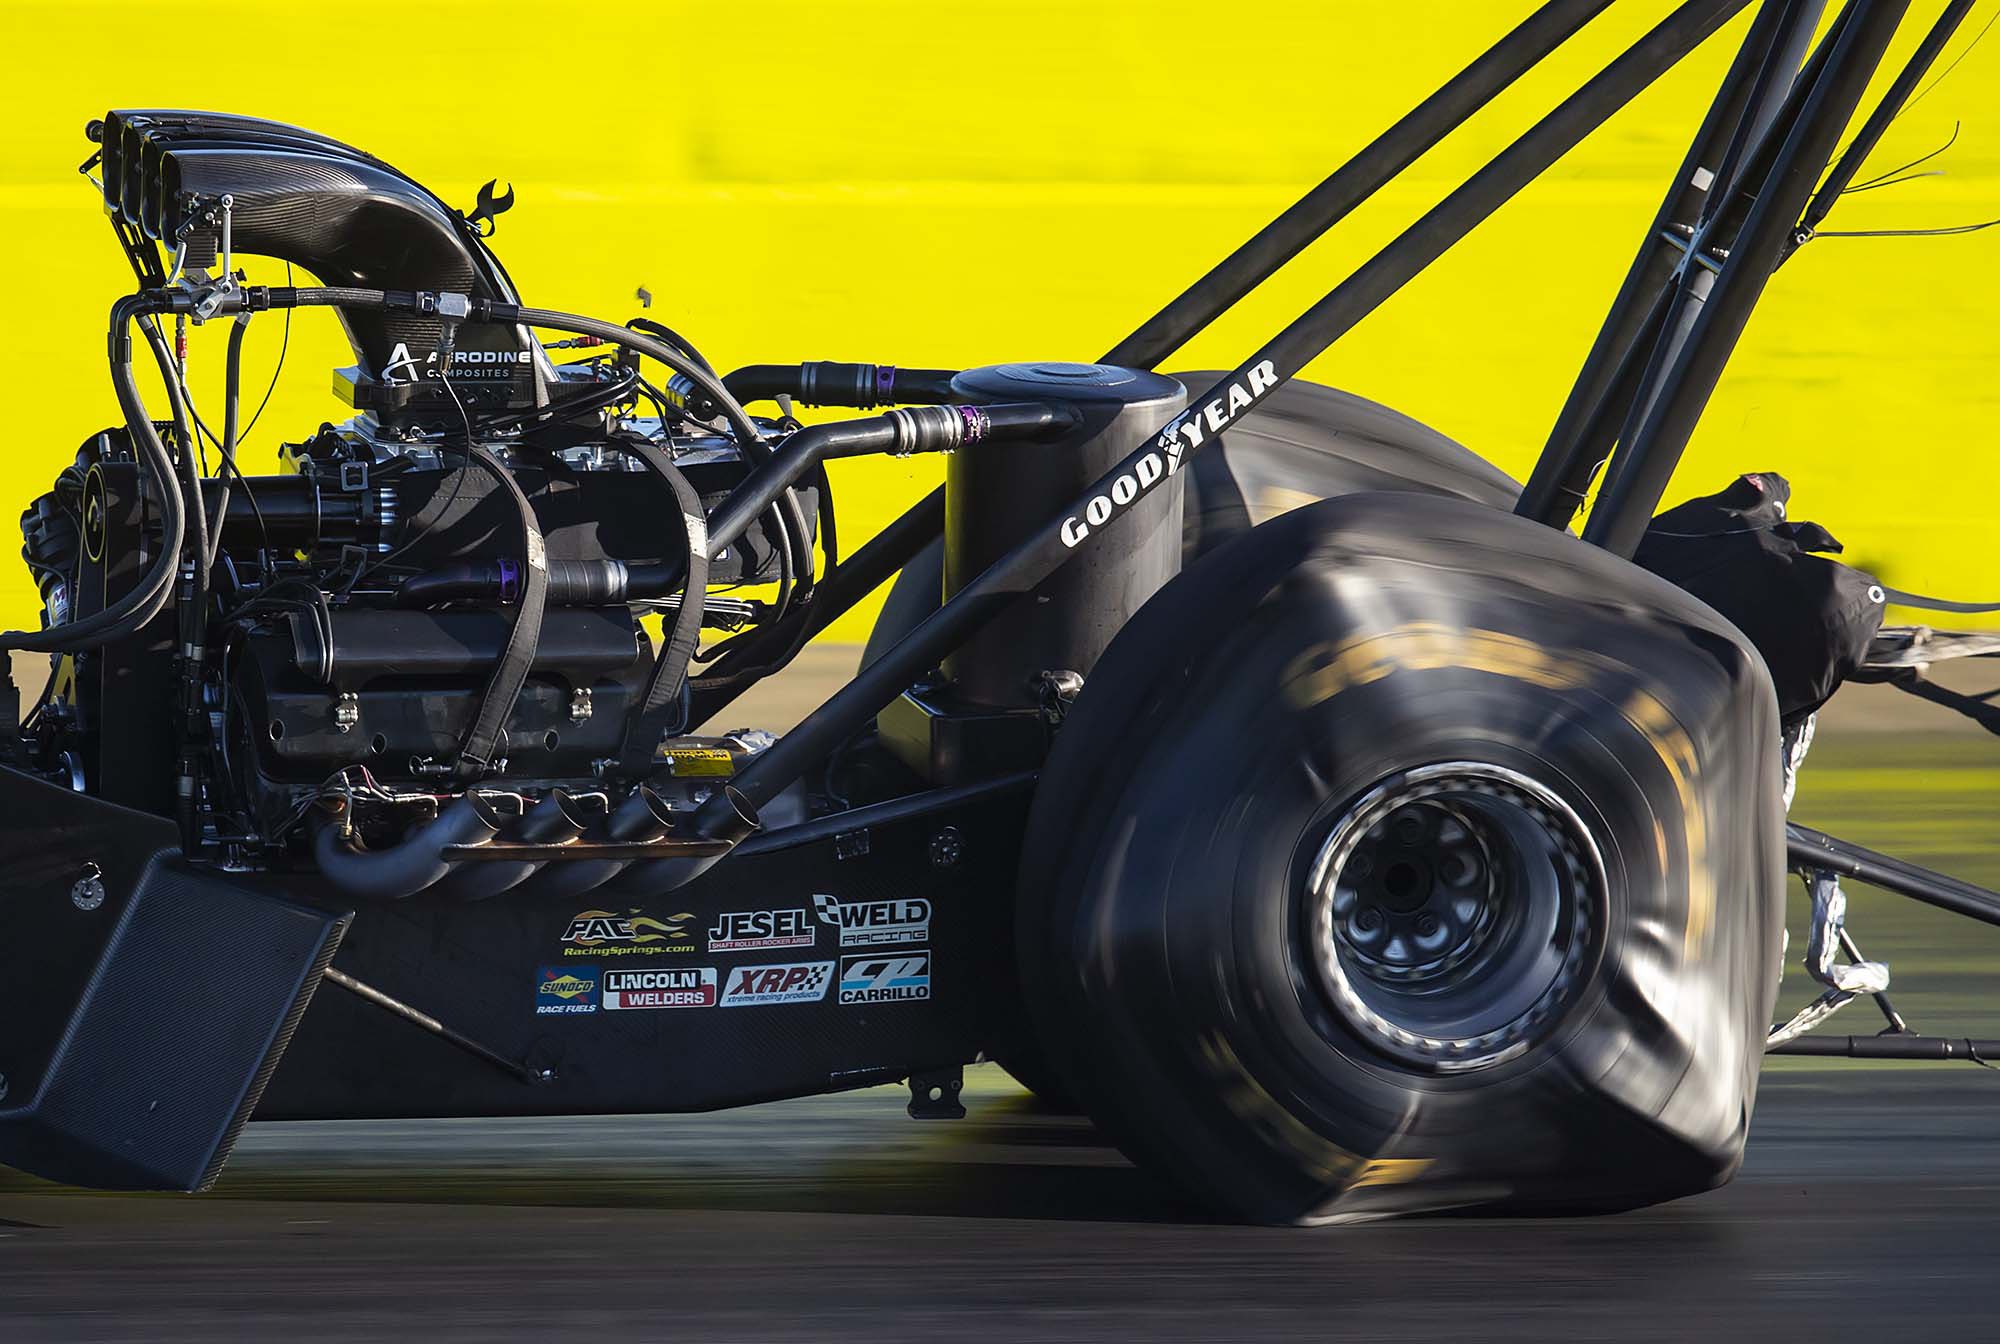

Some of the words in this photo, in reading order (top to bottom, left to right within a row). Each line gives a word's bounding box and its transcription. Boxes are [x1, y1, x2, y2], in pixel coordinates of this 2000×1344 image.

[839, 900, 929, 928] WELD
[560, 918, 637, 941] PAC
[709, 911, 813, 940] JESEL
[711, 941, 734, 949] SHAFT
[735, 940, 762, 948] ROLLER
[762, 938, 791, 946] ROCKER
[791, 937, 811, 945] ARMS
[842, 929, 927, 945] RACING
[563, 945, 695, 957] RacingSprings.com
[844, 957, 928, 987] CP
[541, 981, 593, 993] SUNOCO
[609, 972, 697, 990] LINCOLN
[729, 967, 809, 995] XRP
[628, 992, 705, 1006] WELDERS
[727, 994, 756, 1003] xtreme
[756, 992, 783, 1002] racing
[783, 990, 821, 1000] products
[840, 986, 929, 1003] CARRILLO
[536, 1005, 565, 1014] RACE
[566, 1004, 597, 1013] FUELS
